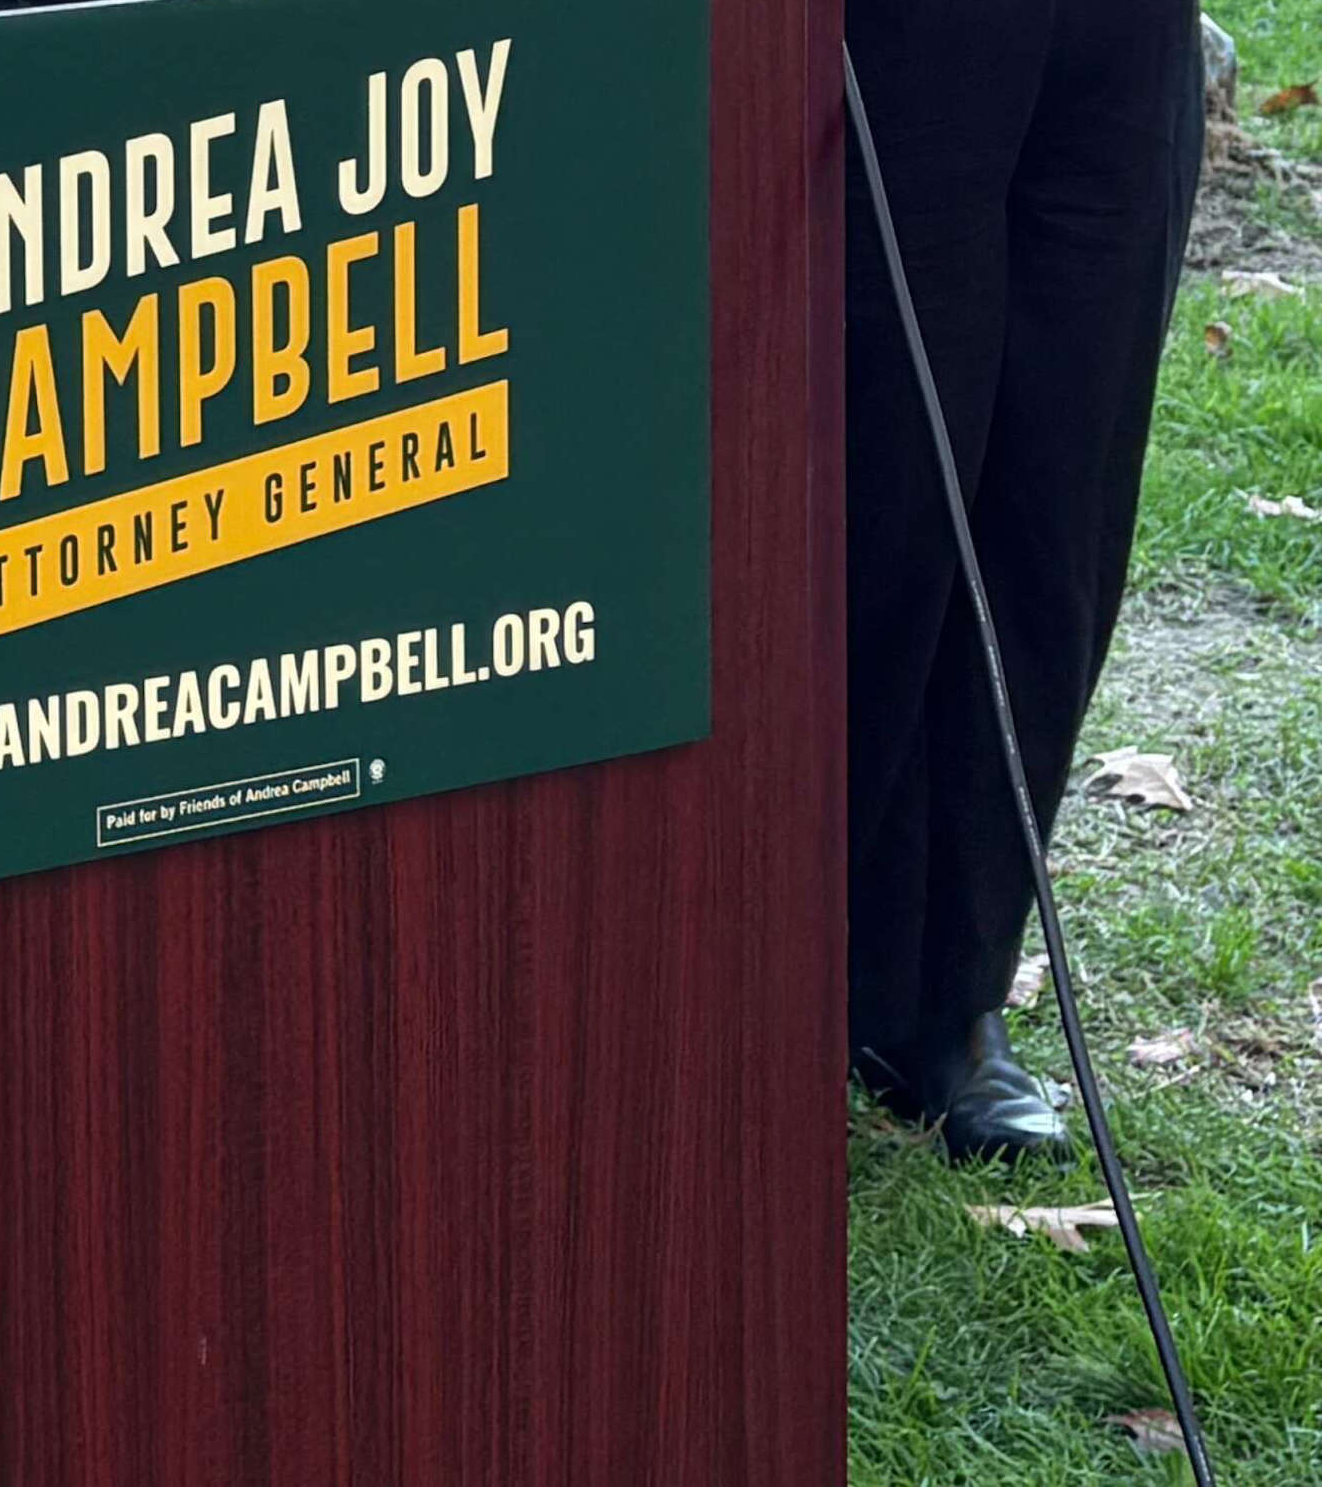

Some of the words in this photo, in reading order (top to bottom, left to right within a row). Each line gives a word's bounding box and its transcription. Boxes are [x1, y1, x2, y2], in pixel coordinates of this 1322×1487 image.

[339, 39, 511, 214] JOY
[265, 413, 486, 523] GENERAL
[106, 813, 136, 830] Paid
[138, 808, 158, 823] for
[160, 804, 176, 822] by
[179, 794, 226, 816] Friends
[229, 789, 243, 806] of
[245, 785, 289, 803] Andrea
[292, 769, 351, 795] Campbell
